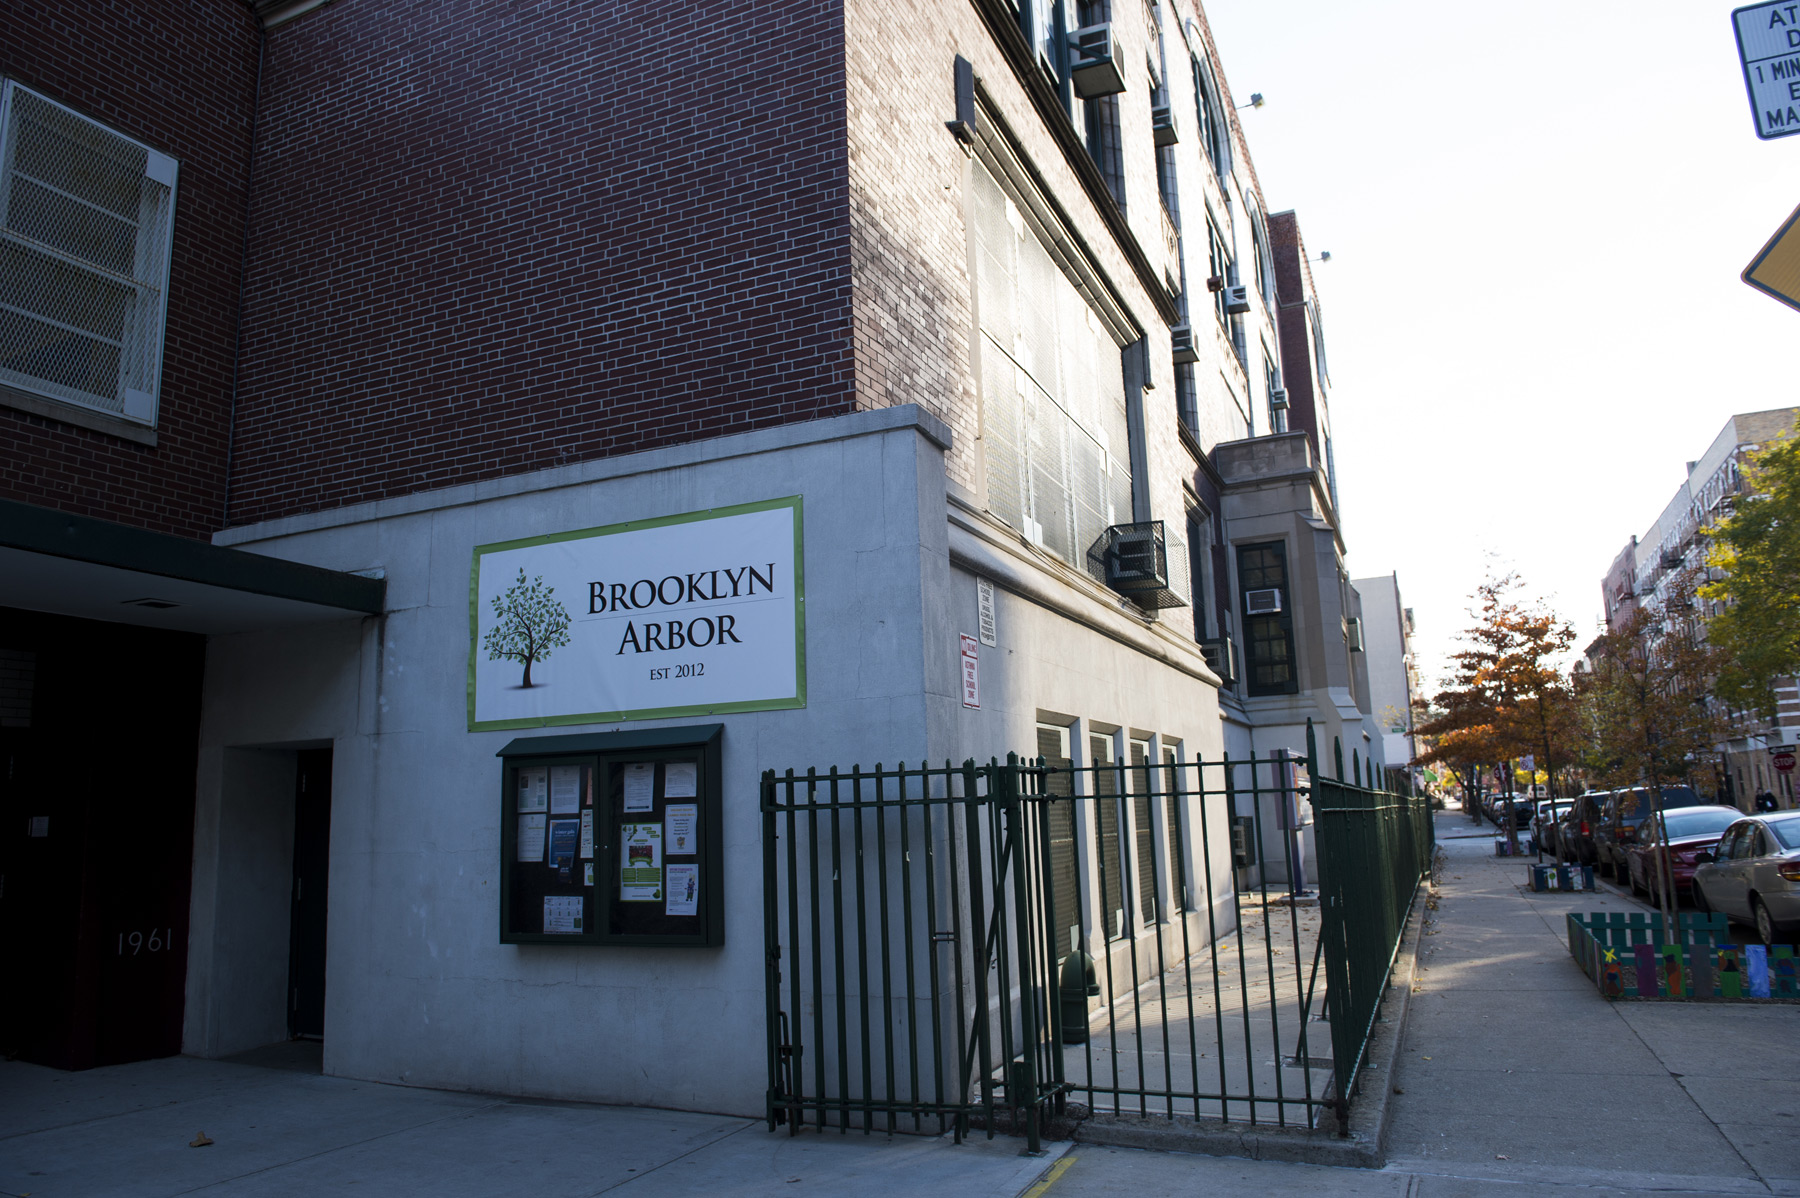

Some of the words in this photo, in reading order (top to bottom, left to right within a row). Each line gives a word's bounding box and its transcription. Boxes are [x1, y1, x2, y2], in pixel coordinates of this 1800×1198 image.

[1755, 65, 1764, 83] 1
[1766, 104, 1800, 128] MA
[587, 562, 776, 615] BROOKLYN
[615, 614, 743, 656] ARBOR
[650, 667, 671, 681] EST
[675, 662, 705, 679] 2012
[1774, 757, 1796, 767] STOP
[118, 927, 171, 956] 1961
